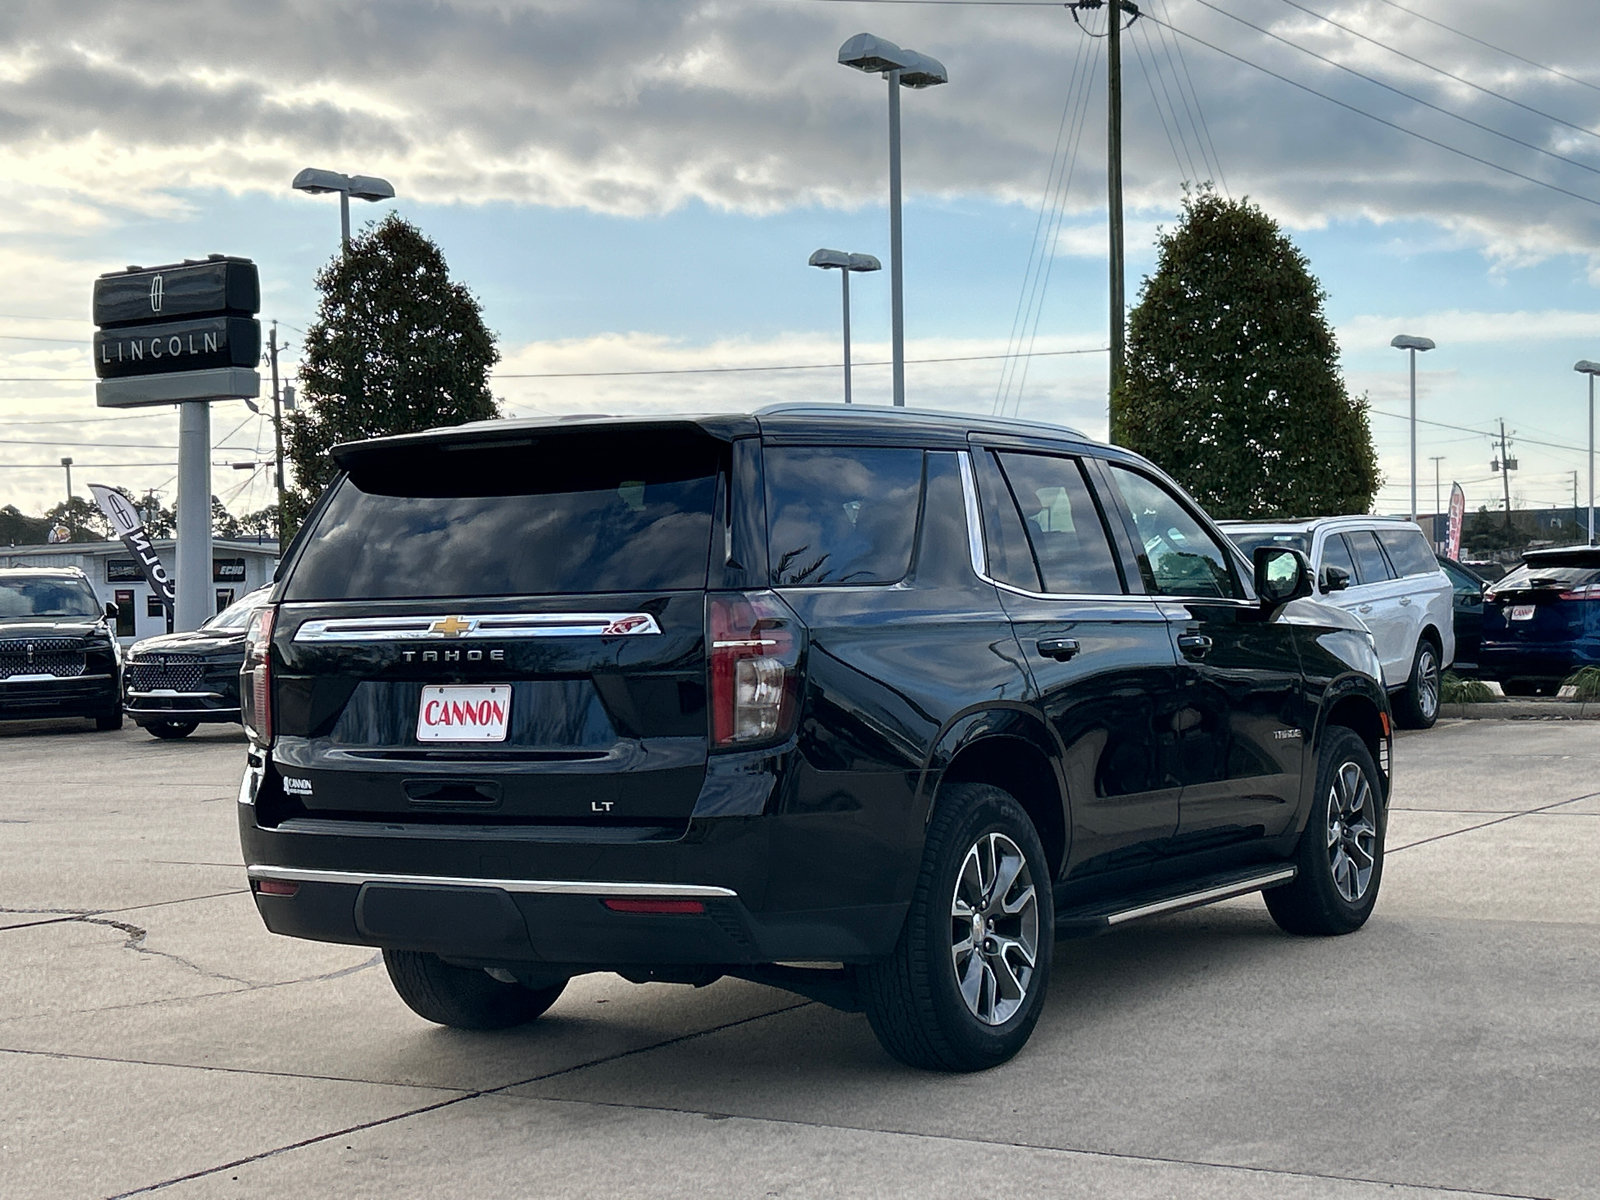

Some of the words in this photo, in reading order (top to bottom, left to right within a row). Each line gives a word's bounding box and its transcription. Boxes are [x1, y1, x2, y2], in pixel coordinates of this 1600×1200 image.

[102, 332, 218, 364] LINCOLN
[219, 565, 244, 575] ECHO
[402, 649, 504, 662] TAHOE
[425, 700, 506, 726] CANNON
[288, 778, 312, 789] CANNON
[591, 801, 614, 811] LT
